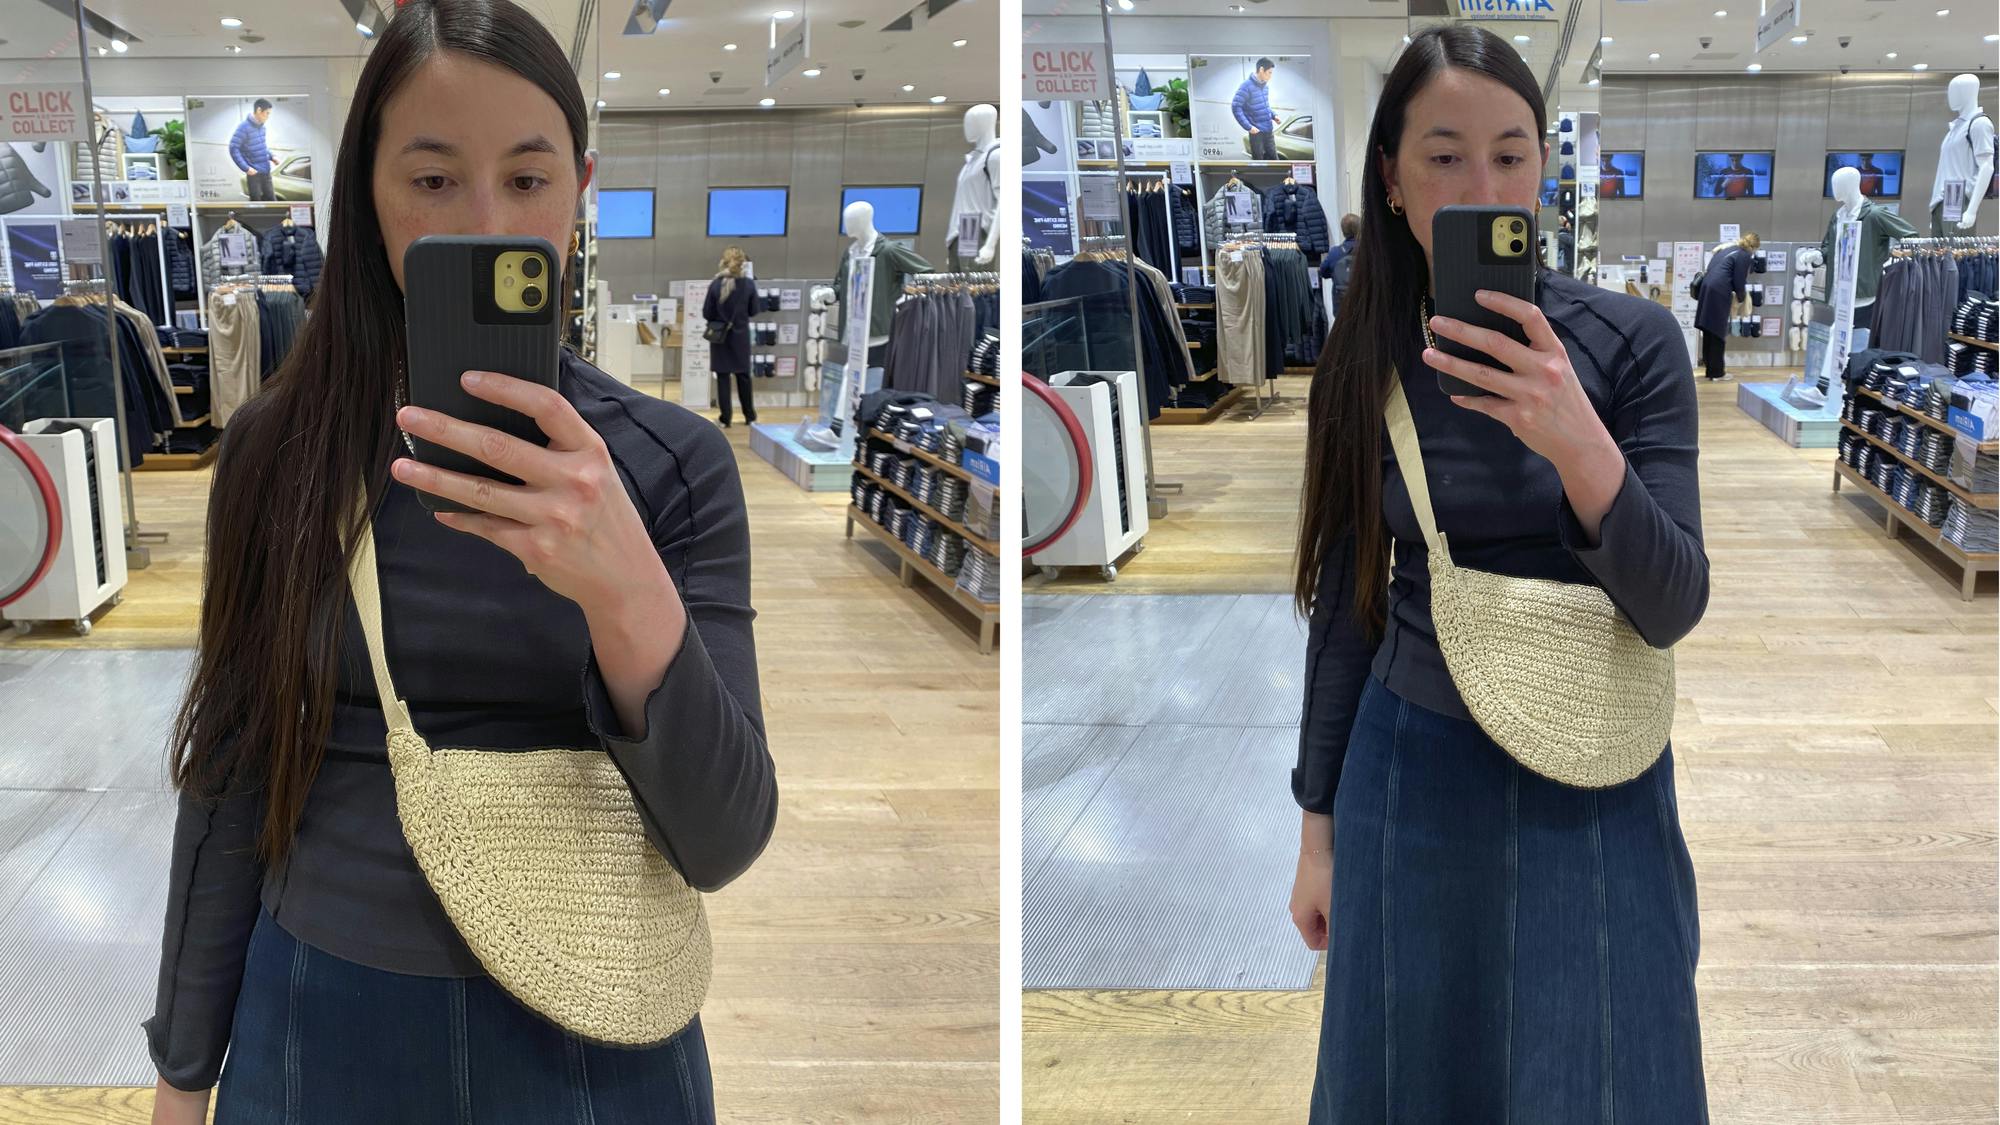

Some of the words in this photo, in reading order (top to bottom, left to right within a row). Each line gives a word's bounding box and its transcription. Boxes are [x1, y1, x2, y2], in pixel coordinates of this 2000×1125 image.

[1032, 50, 1096, 73] CLICK
[1035, 79, 1097, 94] COLLECT
[9, 90, 74, 114] CLICK
[12, 119, 75, 135] COLLECT
